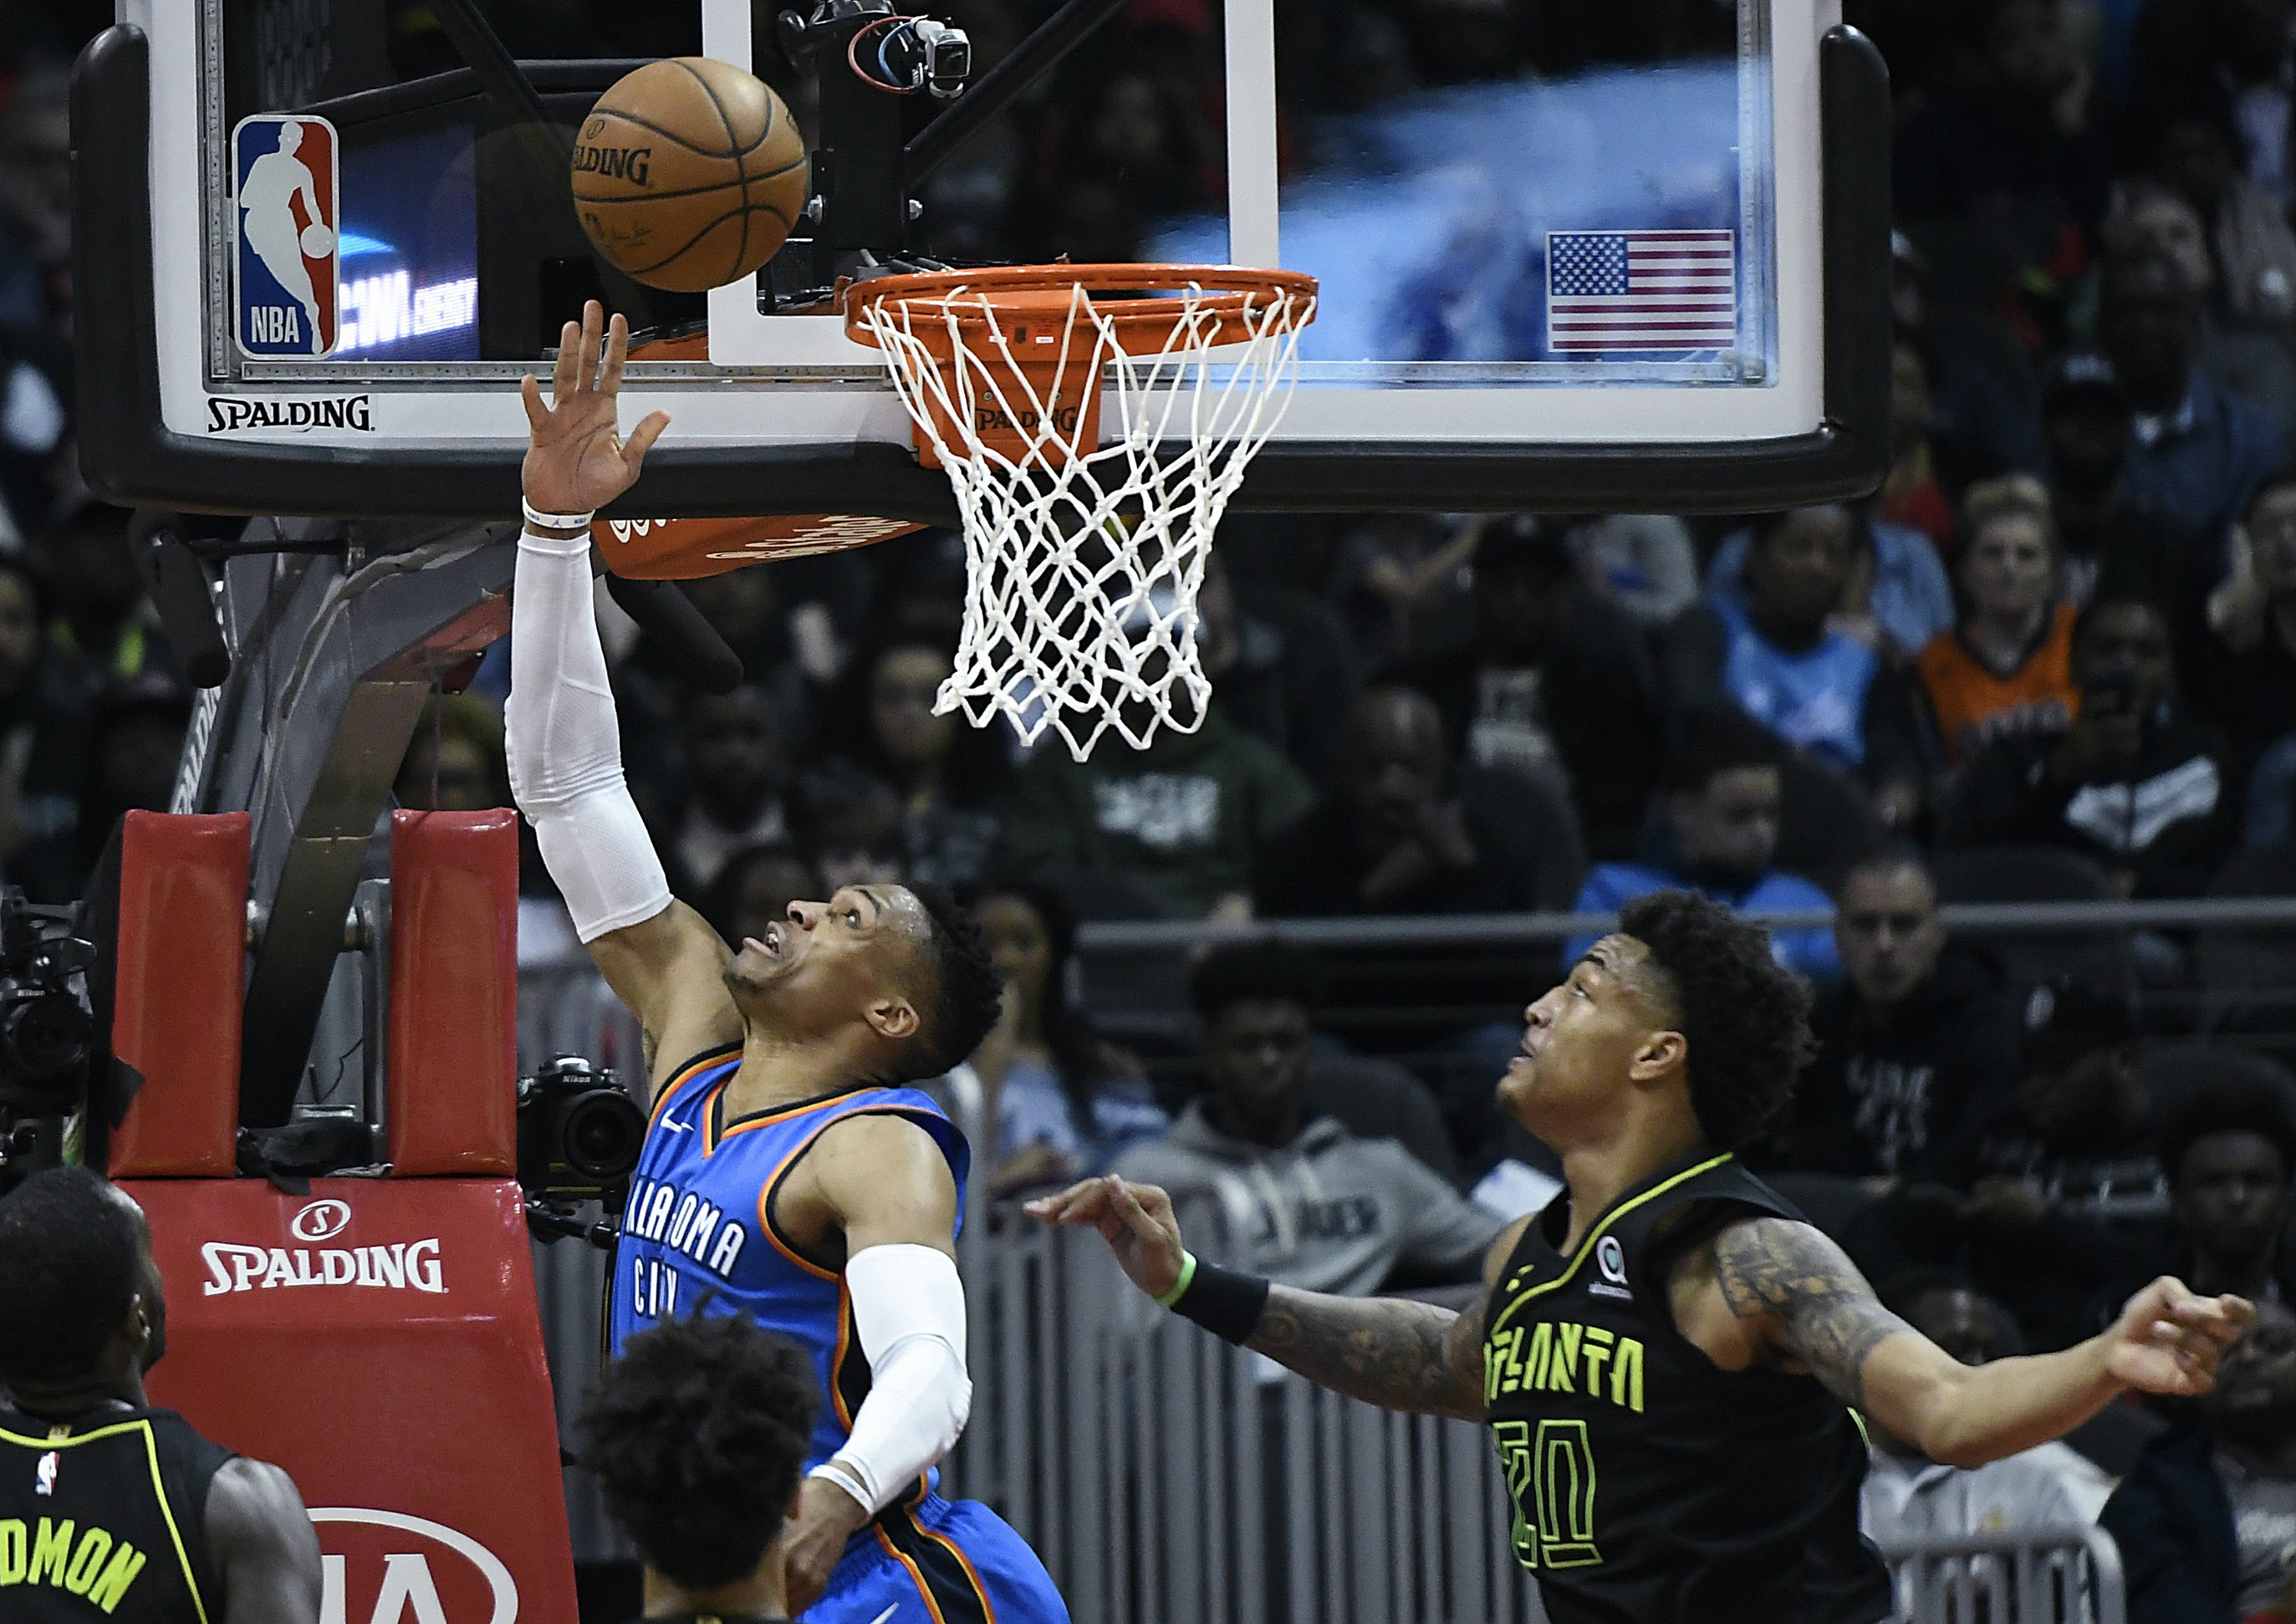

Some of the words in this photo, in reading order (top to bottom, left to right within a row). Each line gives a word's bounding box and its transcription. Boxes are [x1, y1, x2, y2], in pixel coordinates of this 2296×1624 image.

[251, 306, 300, 343] NBA
[207, 395, 370, 432] SPALDING
[201, 1238, 443, 1296] SPALDING
